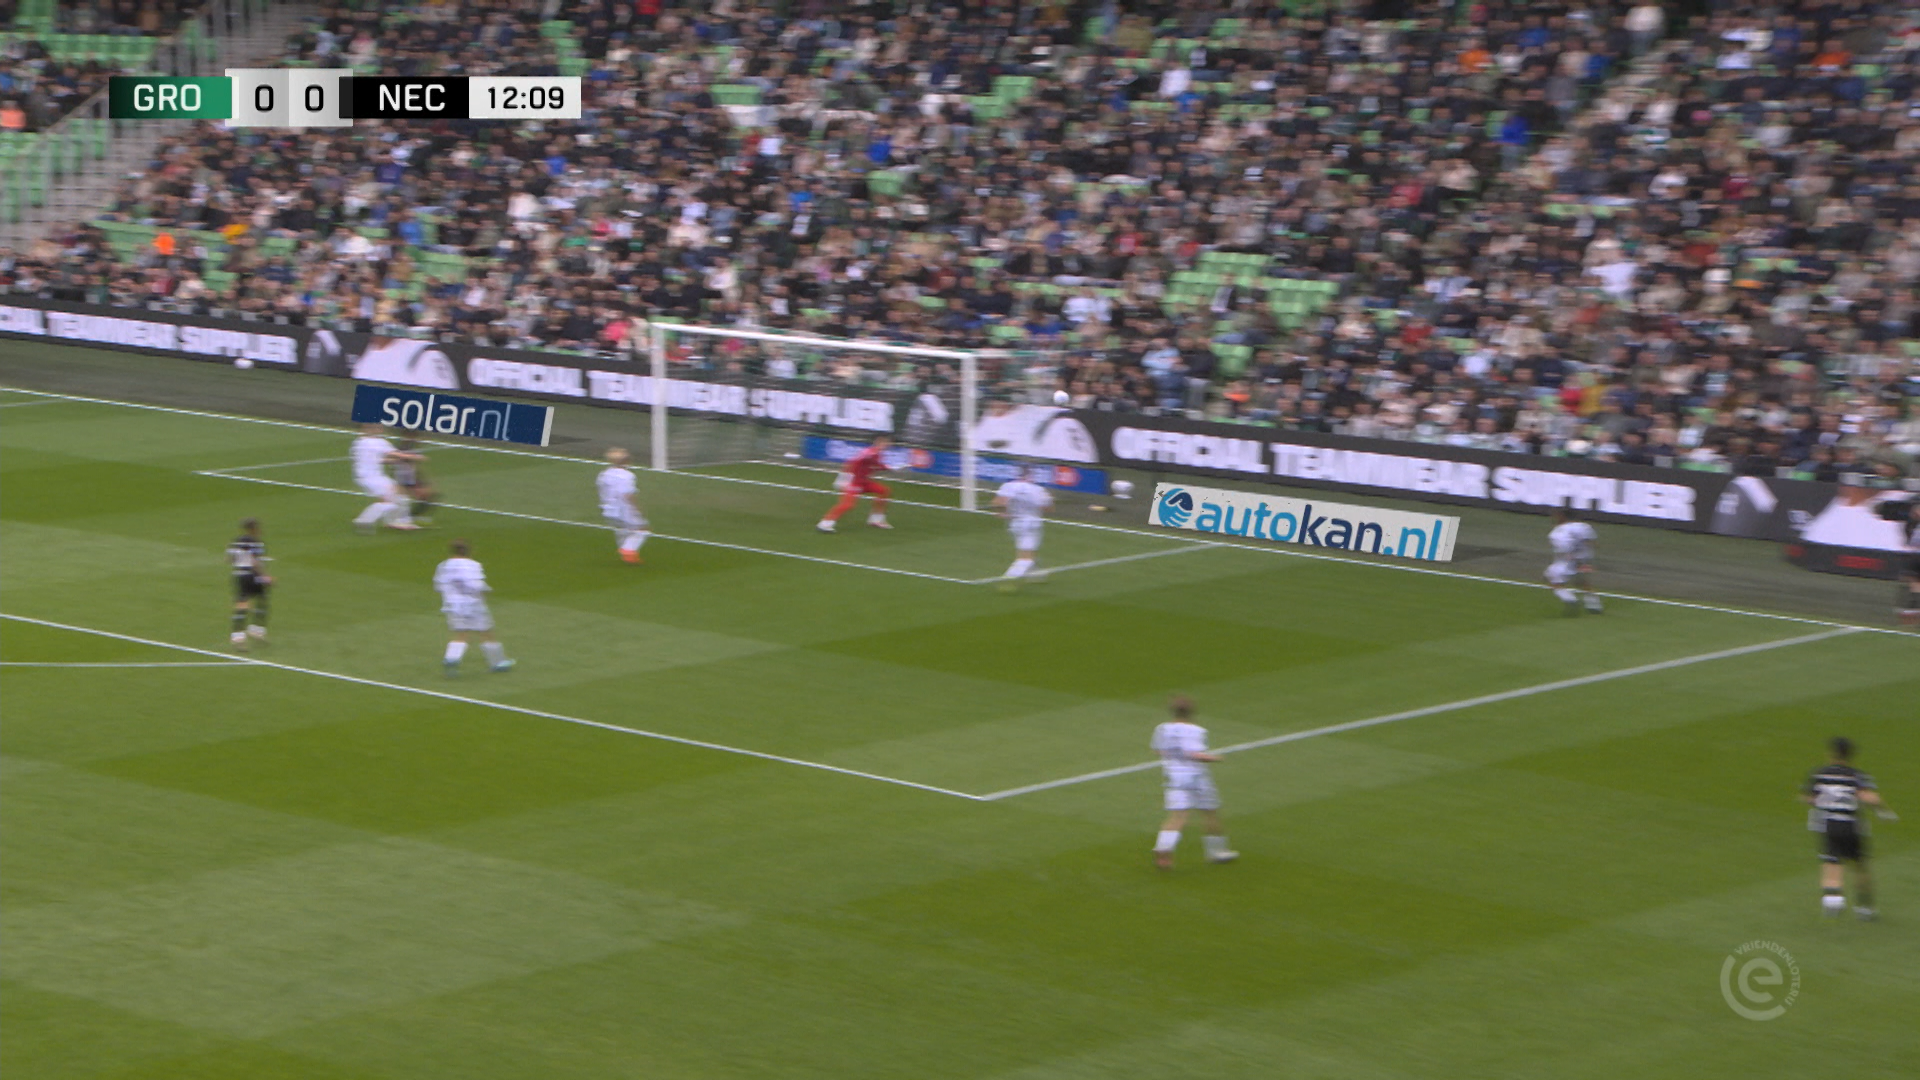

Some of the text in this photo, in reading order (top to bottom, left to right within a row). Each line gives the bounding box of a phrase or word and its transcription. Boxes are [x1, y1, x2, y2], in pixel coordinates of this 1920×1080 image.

[47, 311, 178, 352] TEAMWEAR
[180, 325, 298, 364] SUPPLIER
[380, 393, 512, 442] solar.nl
[468, 357, 587, 397] OFFICIAL
[750, 387, 894, 432] SUPPLIER
[1110, 426, 1269, 473] OFFICIAL
[1270, 443, 1490, 499] TEAMWEAR
[1492, 466, 1696, 521] SUPPLIER
[1195, 501, 1443, 561] autokan.nl
